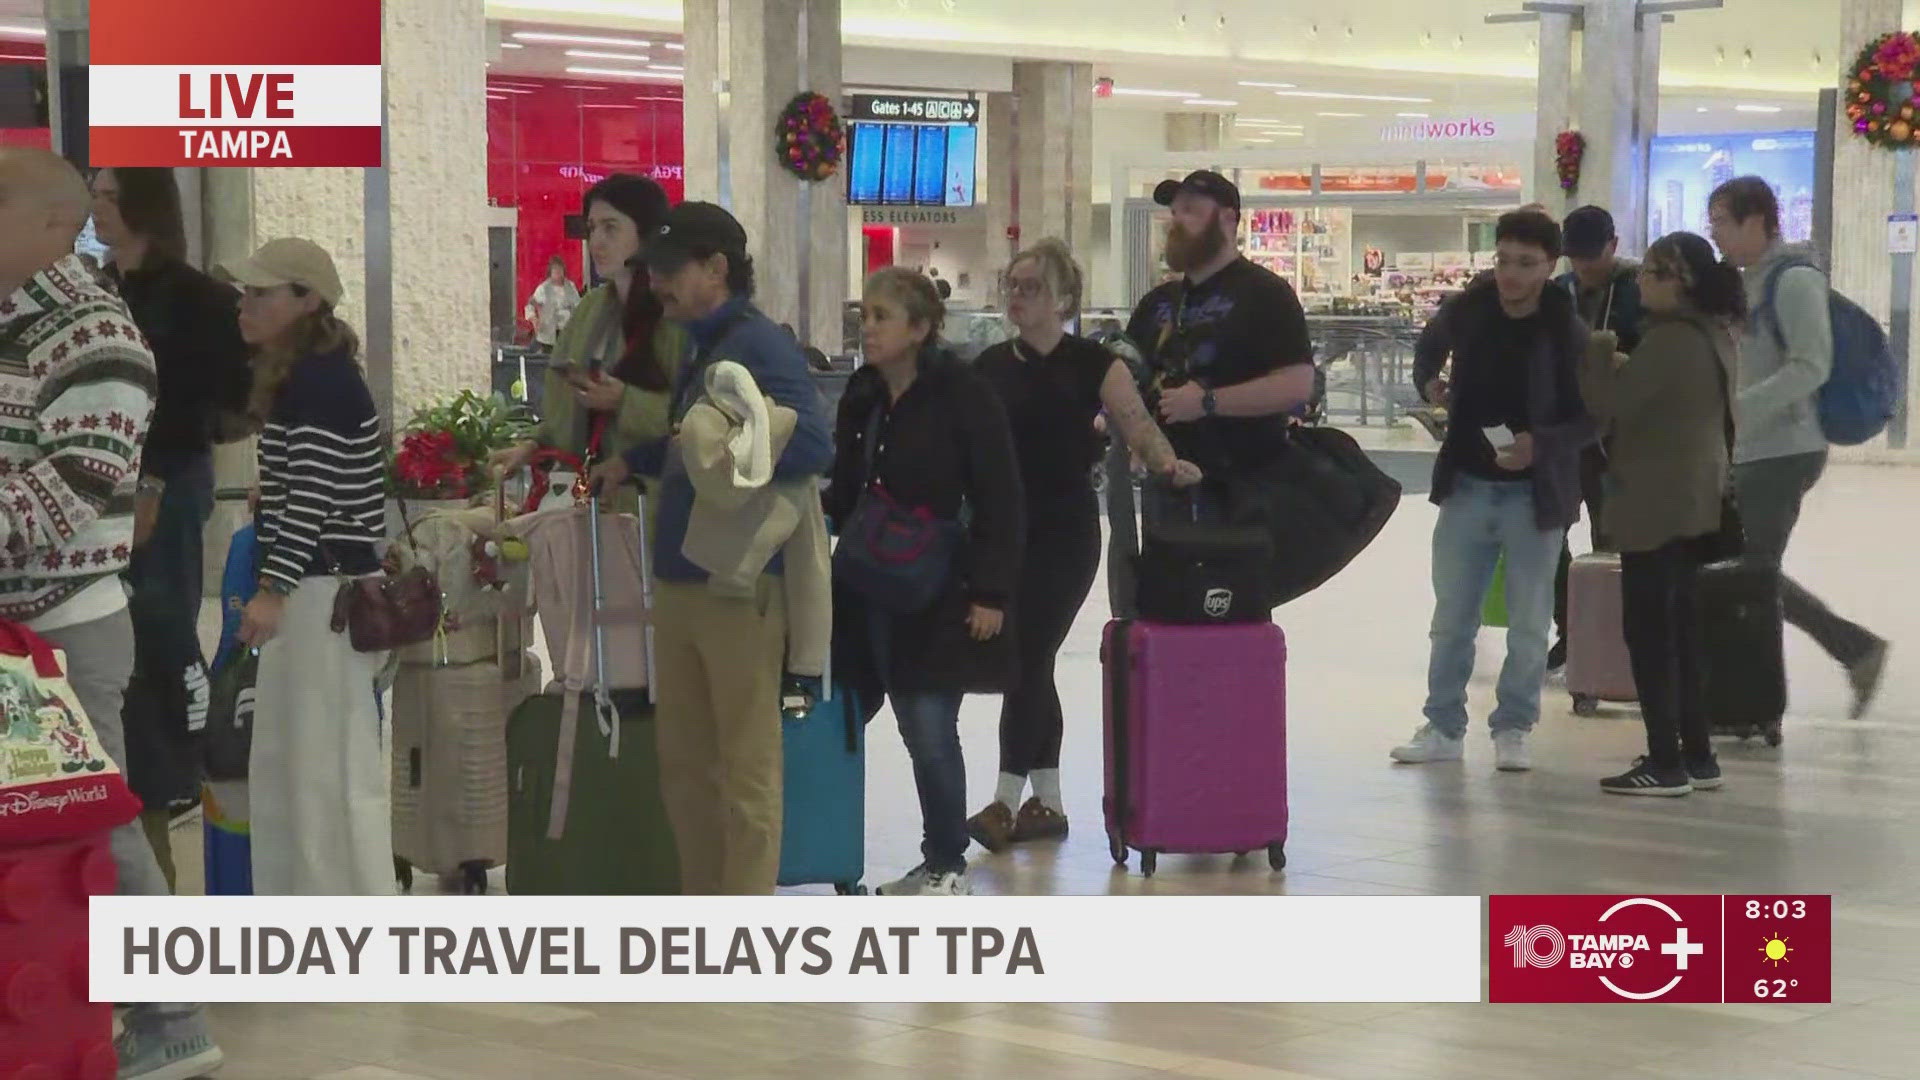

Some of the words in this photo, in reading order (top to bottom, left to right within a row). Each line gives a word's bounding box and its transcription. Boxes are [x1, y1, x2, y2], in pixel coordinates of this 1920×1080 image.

[871, 99, 900, 115] Gates
[902, 101, 924, 116] 1-45
[889, 211, 957, 223] ELEVATORS
[66, 784, 108, 804] World
